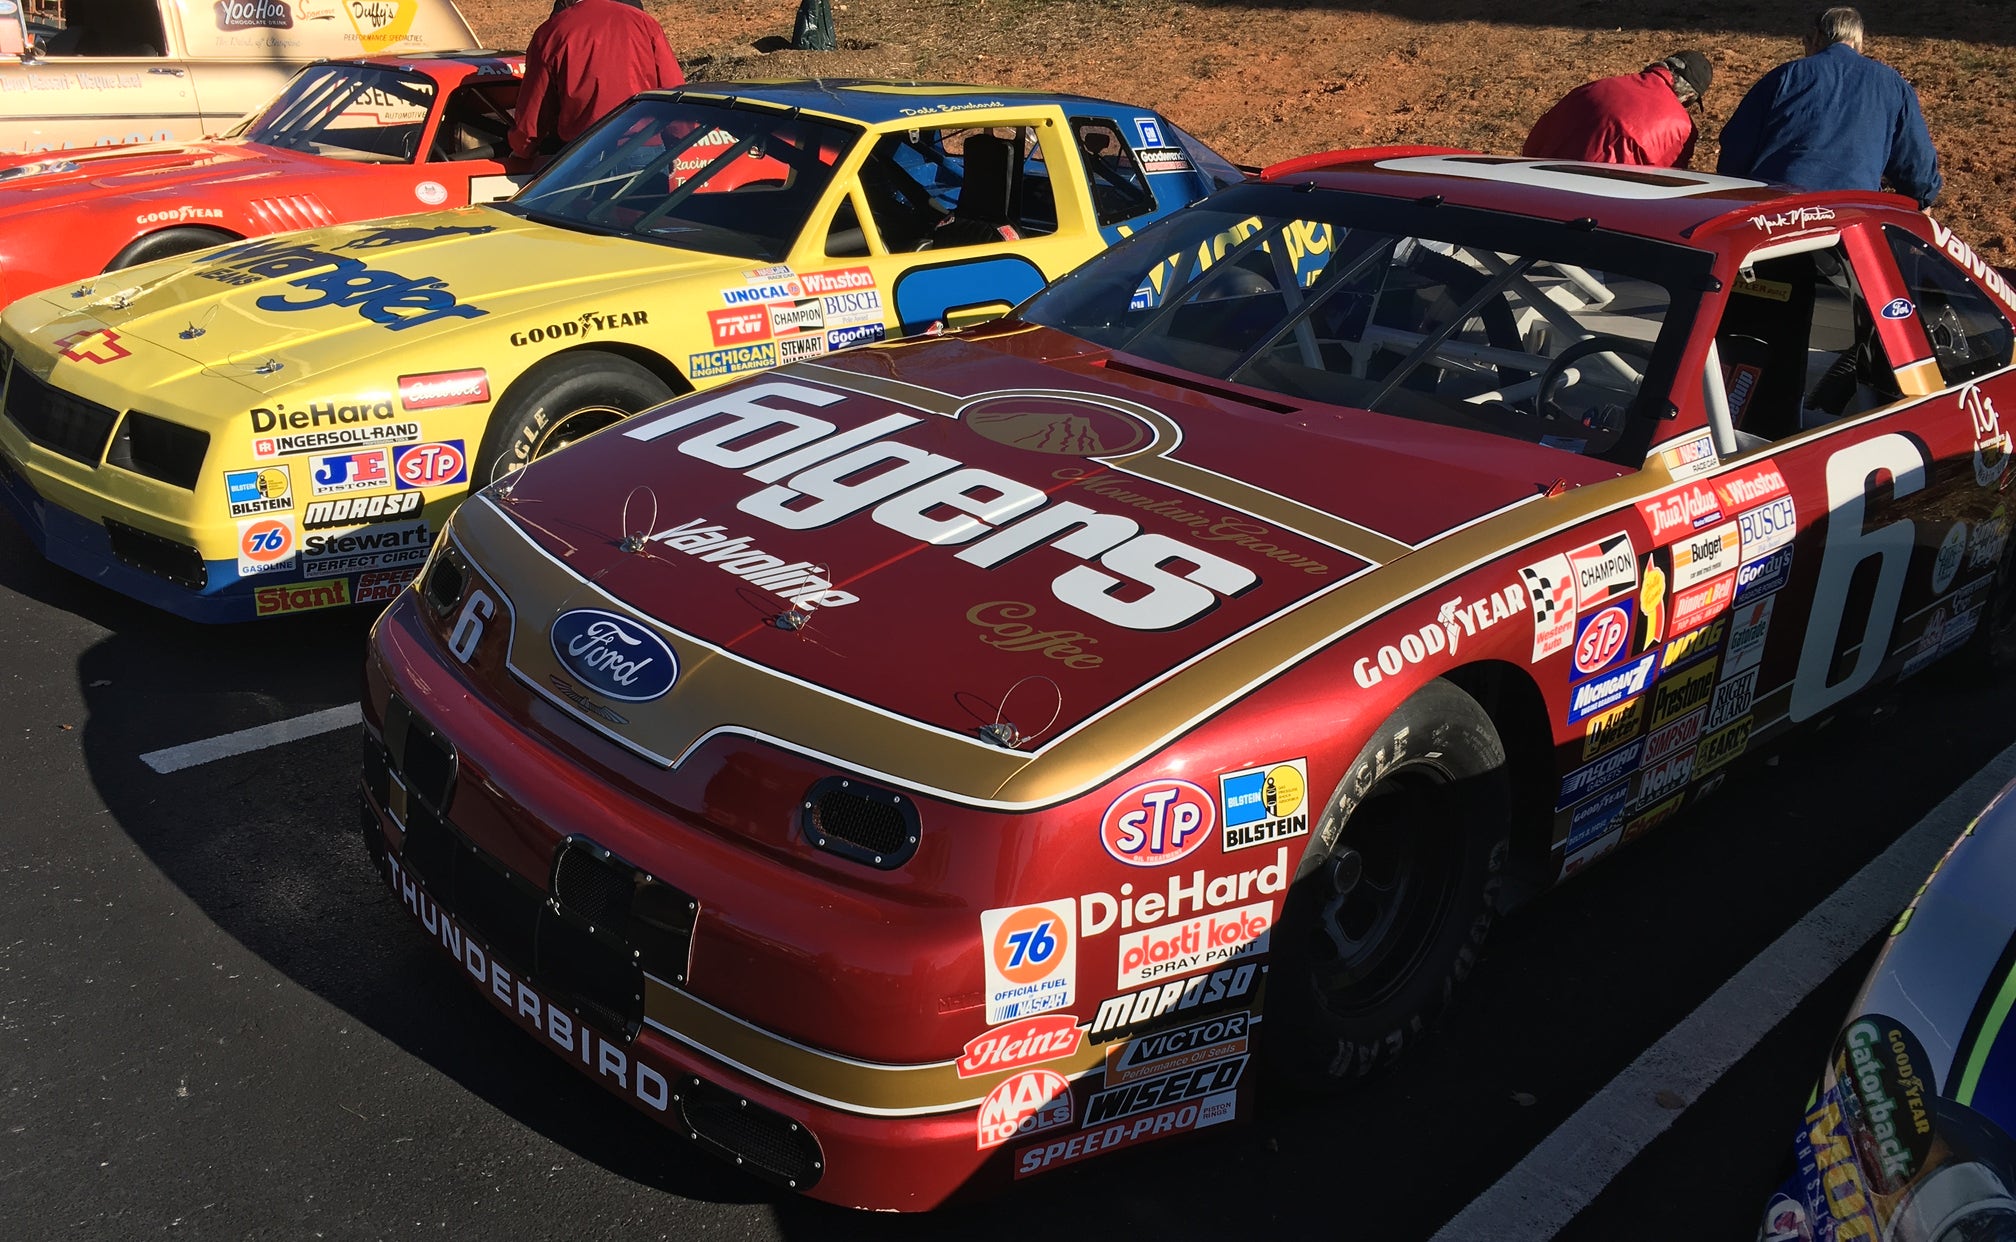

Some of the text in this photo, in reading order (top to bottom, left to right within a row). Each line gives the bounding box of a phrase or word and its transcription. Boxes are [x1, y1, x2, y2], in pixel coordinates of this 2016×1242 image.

[352, 1, 395, 28] Duffy's
[343, 33, 423, 42] PERFORMANCE SPECIALTIES
[899, 106, 938, 116] Dale
[136, 205, 224, 224] GOODYEAR
[1749, 205, 1837, 235] Mark Martin
[723, 285, 790, 304] UNOCAL
[801, 271, 874, 293] Winston
[774, 308, 821, 326] CHAMPION
[823, 291, 880, 315] BUSCH
[510, 310, 649, 347] GOODYEAR
[716, 313, 763, 338] TRW
[828, 324, 884, 345] Goody's
[692, 343, 775, 371] MICHIGAN
[781, 336, 822, 356] STEWART
[692, 365, 727, 378] ENGINE
[731, 359, 775, 372] BEARINGS
[250, 400, 396, 434] DieHard
[276, 422, 419, 450] INGERSOLL-RAND
[315, 452, 386, 485] JE
[405, 446, 455, 480] STP
[1692, 457, 1718, 472] RACE CAR
[317, 479, 389, 493] PISTONS
[1727, 470, 1786, 505] Winston
[231, 497, 292, 515] BILSTEIN
[304, 492, 422, 525] MOROSO
[622, 382, 1257, 631] Folgers
[1051, 467, 1329, 576] Mountain Grown
[1739, 499, 1795, 546] BUSCH
[250, 528, 284, 553] 76
[304, 523, 429, 557] Stewart
[1691, 535, 1722, 564] Budget
[242, 561, 293, 574] GASOLINE
[306, 548, 431, 573] PERFECT CIRCL
[646, 518, 861, 610] Valvoline
[1581, 552, 1632, 588] CHAMPION
[1738, 550, 1792, 586] Goody's
[357, 584, 401, 601] PRO
[1789, 432, 1928, 724] 6
[256, 580, 345, 614] Stant
[1675, 590, 1709, 618] Dinner
[1711, 578, 1732, 603] Bell
[448, 589, 496, 665] 6
[966, 600, 1105, 673] Coffee
[1353, 583, 1527, 689] GOODYEAR
[1536, 621, 1573, 645] Western
[1579, 613, 1622, 665] STP
[1661, 617, 1727, 669] MOOG
[1731, 620, 1766, 650] Gatorade
[569, 620, 653, 686] Ford
[1542, 637, 1562, 654] Auto
[1573, 674, 1634, 712] MICHIGAN
[1653, 671, 1713, 723] Prestone
[1716, 671, 1755, 707] RIGHT
[1606, 704, 1637, 730] Auto
[1710, 693, 1751, 728] GUARD
[1600, 716, 1639, 746] Meter
[1645, 715, 1699, 761] SIMPSON
[1586, 767, 1622, 793] GASKETS
[1640, 754, 1694, 800] Holley
[1227, 790, 1262, 809] BILSTEIN
[1573, 787, 1628, 823] GOODYEAR
[1115, 786, 1202, 853] STP
[1226, 814, 1306, 848] BILSTEIN
[1133, 849, 1183, 862] OIL TREATMENT
[1080, 846, 1289, 938] DieHard
[1004, 919, 1056, 971] 76
[1122, 911, 1268, 975] plasti kote
[1140, 940, 1258, 979] SPRAY PAINT
[387, 851, 669, 1112] THUNDERBIRD
[994, 978, 1068, 1001] OFFICIAL FUEL
[1018, 991, 1068, 1015] NASCAR
[1091, 963, 1257, 1036] MOROSO
[963, 1026, 1075, 1071] Heinz
[1140, 1016, 1243, 1060] VICTOR
[1122, 1043, 1236, 1081] Performance Oil Seals
[1093, 1061, 1242, 1122] WISECO
[1888, 1029, 1931, 1135] GOODYEAR
[982, 1073, 1069, 1126] MAC
[1202, 1107, 1228, 1120] RINGS
[1203, 1101, 1232, 1114] PISTON
[1847, 1020, 1915, 1180] Gatorback
[982, 1106, 1070, 1143] TOOLS
[1019, 1104, 1199, 1174] SPEED-PRO
[1794, 1131, 1833, 1238] CHASSIS
